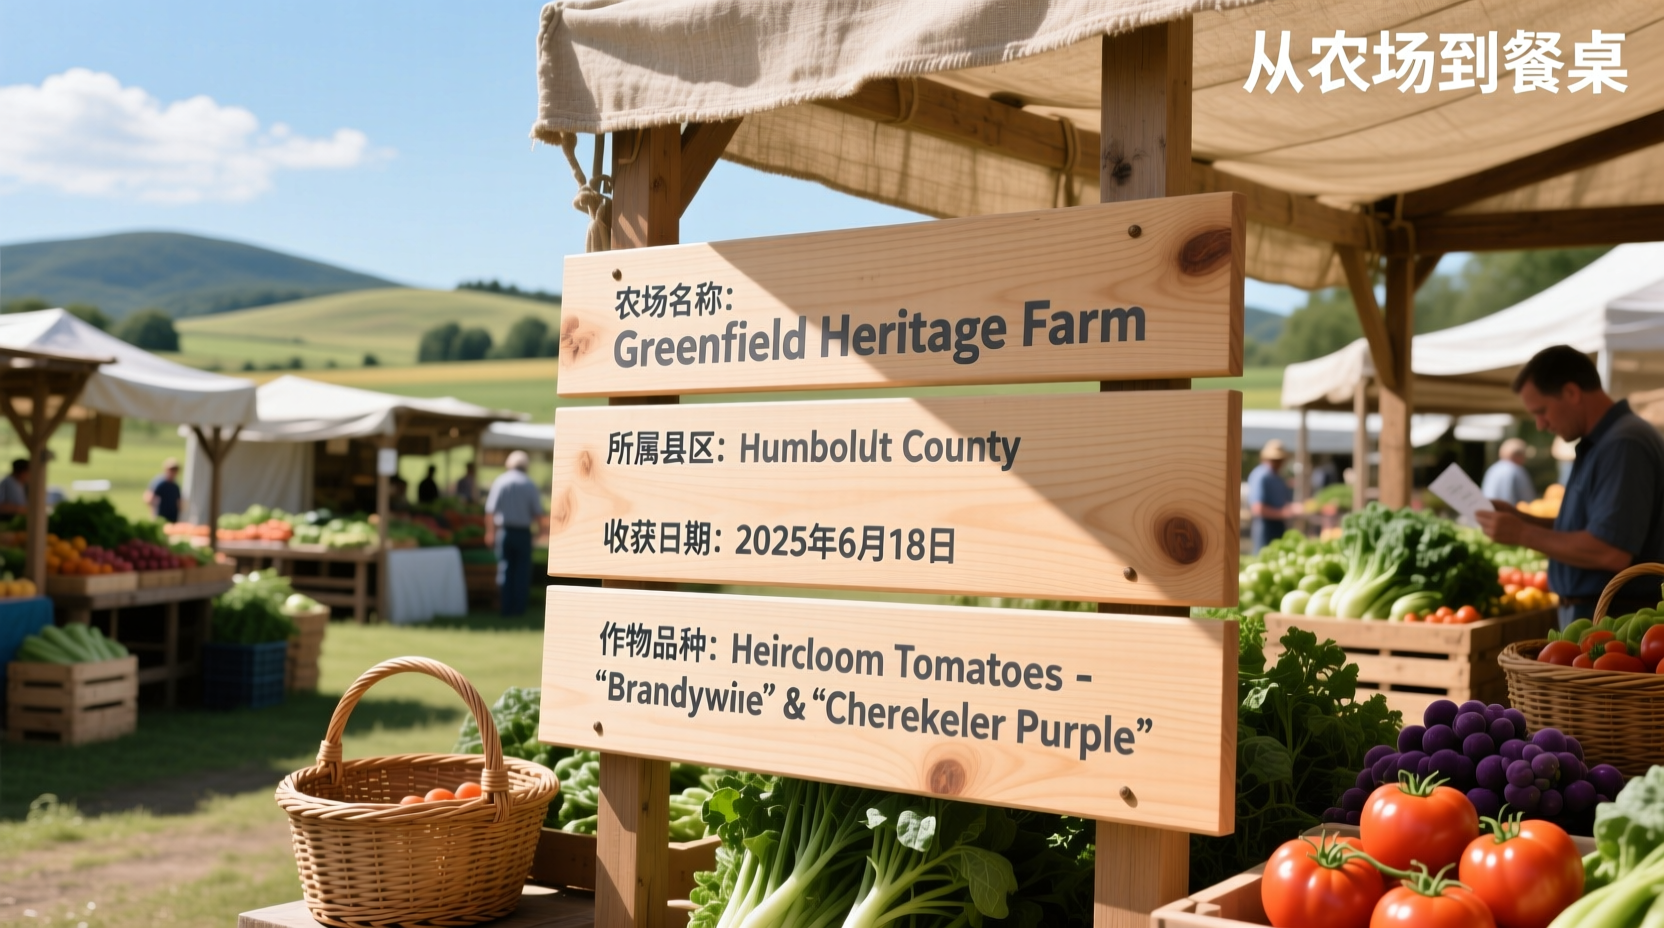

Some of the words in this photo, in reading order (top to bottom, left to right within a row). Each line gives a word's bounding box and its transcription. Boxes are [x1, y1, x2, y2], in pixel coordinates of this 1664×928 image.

[614, 281, 733, 320] 农场名称：
[613, 315, 807, 368] Greenfield
[820, 307, 1007, 365] Heritage
[1022, 299, 1146, 347] Farm
[606, 430, 725, 465] 所属县区：
[902, 430, 1022, 472] County
[603, 518, 722, 556] 收获日期：
[735, 522, 955, 564] 2025年6月18日
[599, 620, 717, 663] 作物品种：
[732, 633, 884, 677] Heircloom
[894, 644, 1063, 691] Tomatoes
[783, 686, 806, 721] &
[812, 687, 1007, 741] “Cherekeler
[1016, 709, 1153, 761] Purple”
